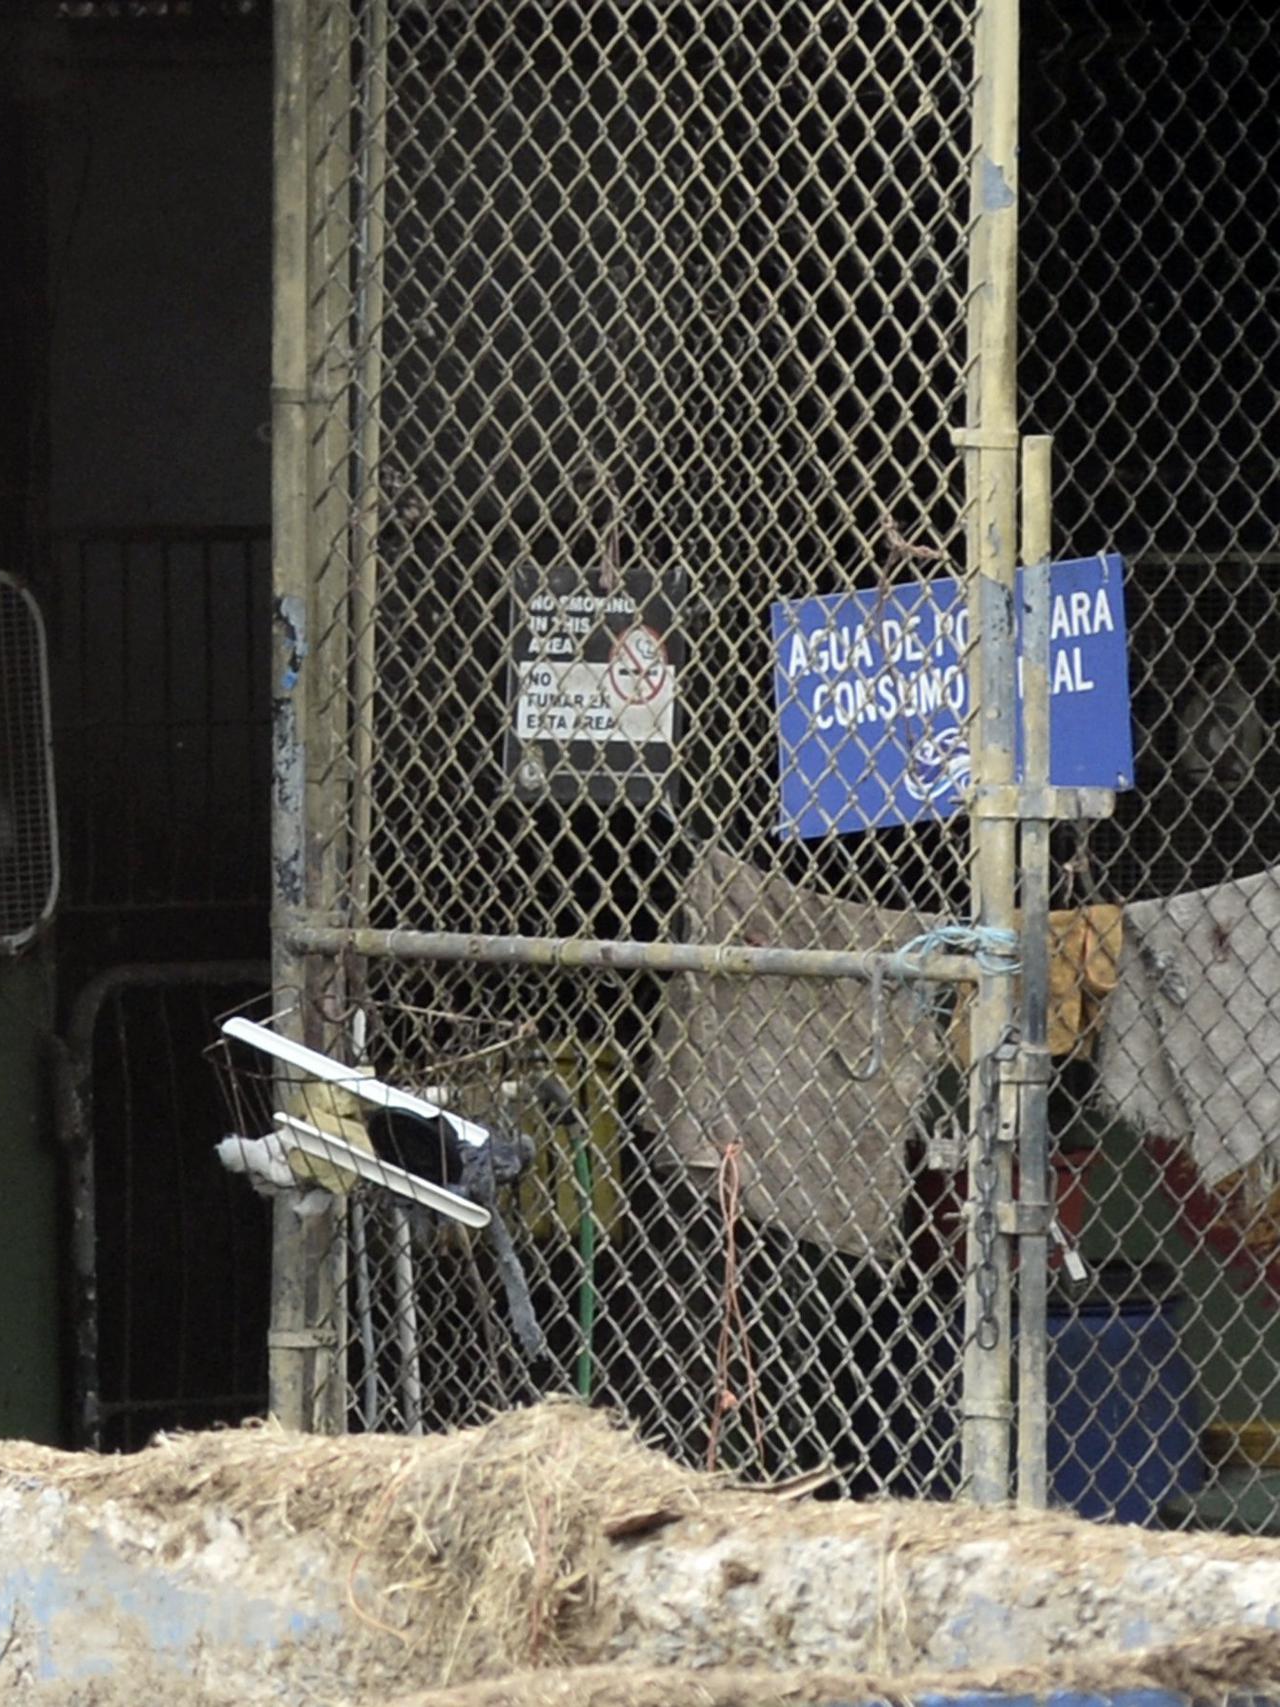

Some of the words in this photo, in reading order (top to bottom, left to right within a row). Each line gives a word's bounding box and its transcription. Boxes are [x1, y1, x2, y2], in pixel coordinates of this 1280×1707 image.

[530, 596, 554, 612] NO
[529, 616, 548, 632] IN
[789, 624, 874, 677] AGUA
[881, 616, 926, 663] DE
[1051, 588, 1114, 640] ARA
[528, 672, 552, 687] NO
[813, 665, 965, 729] CONSUMO
